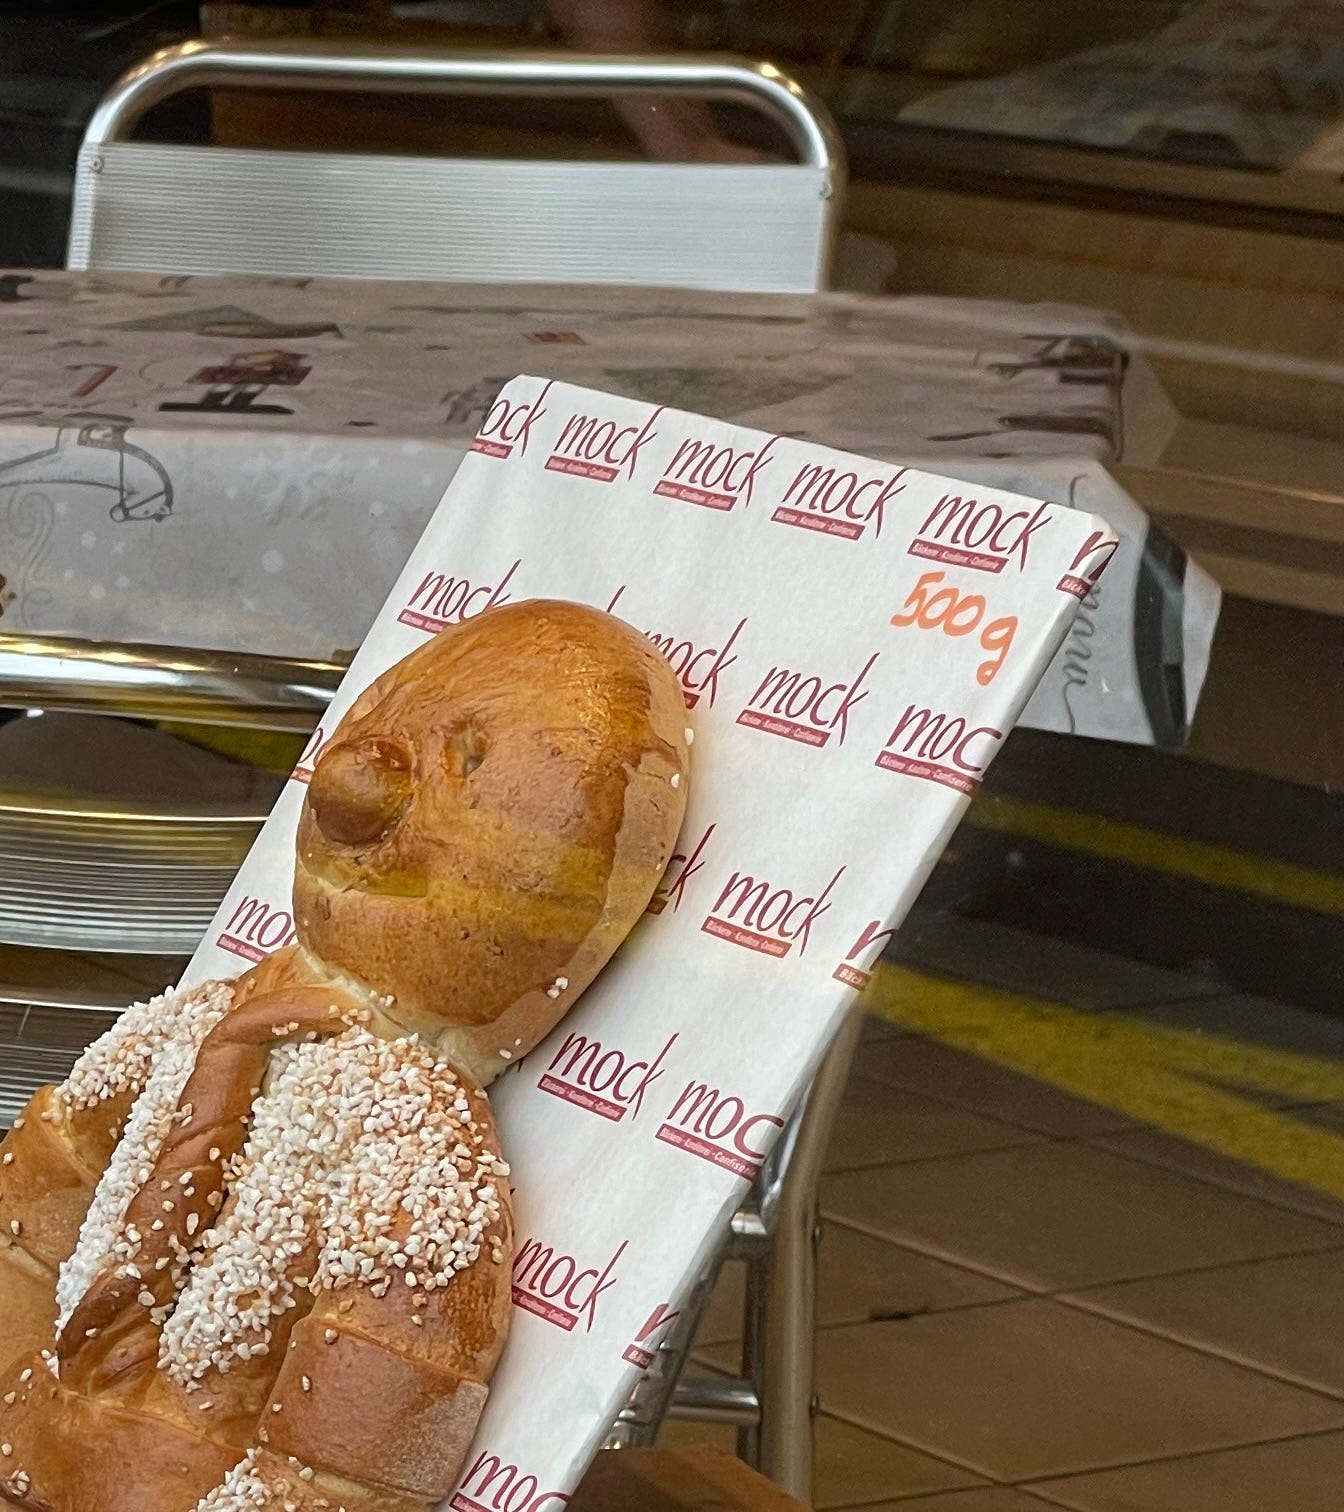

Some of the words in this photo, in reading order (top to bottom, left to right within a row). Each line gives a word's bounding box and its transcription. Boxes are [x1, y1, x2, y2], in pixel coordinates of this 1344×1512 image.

[478, 380, 555, 457] ock
[553, 406, 664, 480] mock
[662, 435, 780, 508] mock
[782, 467, 910, 539] mock
[918, 494, 1052, 573] mock
[748, 652, 880, 746] mock
[885, 704, 1003, 772] moc
[712, 865, 847, 957] mock
[548, 1032, 680, 1121] mock
[667, 1080, 785, 1160] moc
[512, 1238, 630, 1334] mock
